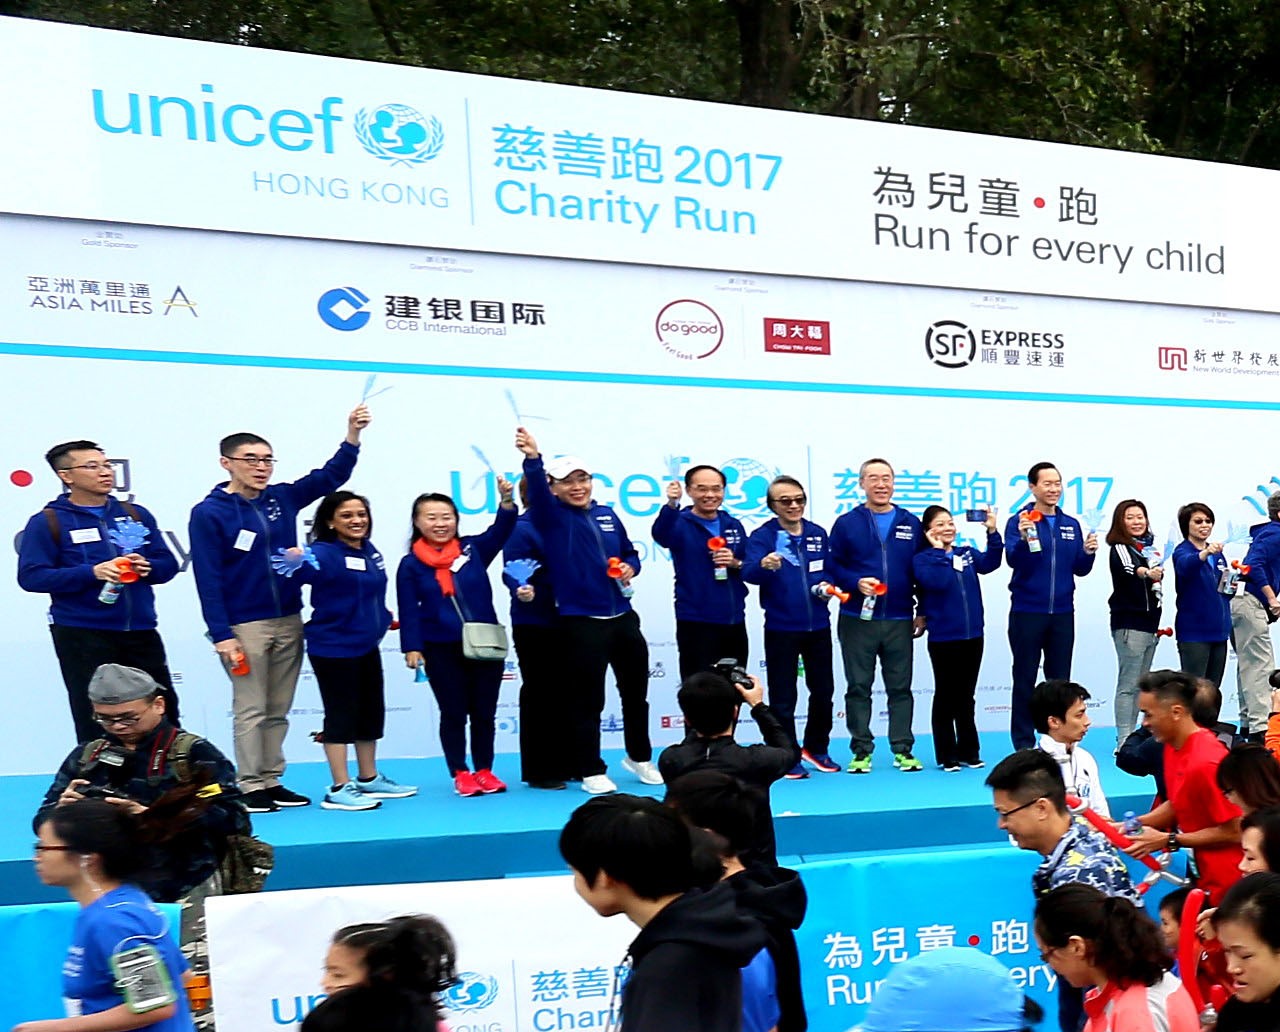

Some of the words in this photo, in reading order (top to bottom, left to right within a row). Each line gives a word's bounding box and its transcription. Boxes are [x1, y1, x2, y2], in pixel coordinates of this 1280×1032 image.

[92, 85, 344, 154] unicef
[252, 170, 350, 201] HONG
[361, 180, 450, 209] KONG
[493, 179, 660, 233] Charity
[674, 197, 758, 235] Run
[873, 213, 951, 253] Run
[964, 221, 1020, 258] for
[1032, 235, 1134, 275] every
[1145, 240, 1227, 276] child
[27, 275, 152, 299] 亞洲萬里通
[30, 295, 83, 312] ASIA
[90, 299, 153, 316] MILES
[384, 295, 546, 326] 建银国际
[385, 319, 418, 331] CCB
[423, 321, 507, 337] International
[772, 323, 823, 341] 周大福
[981, 329, 1065, 350] EXPRESS
[981, 348, 1065, 369] 順豐速運
